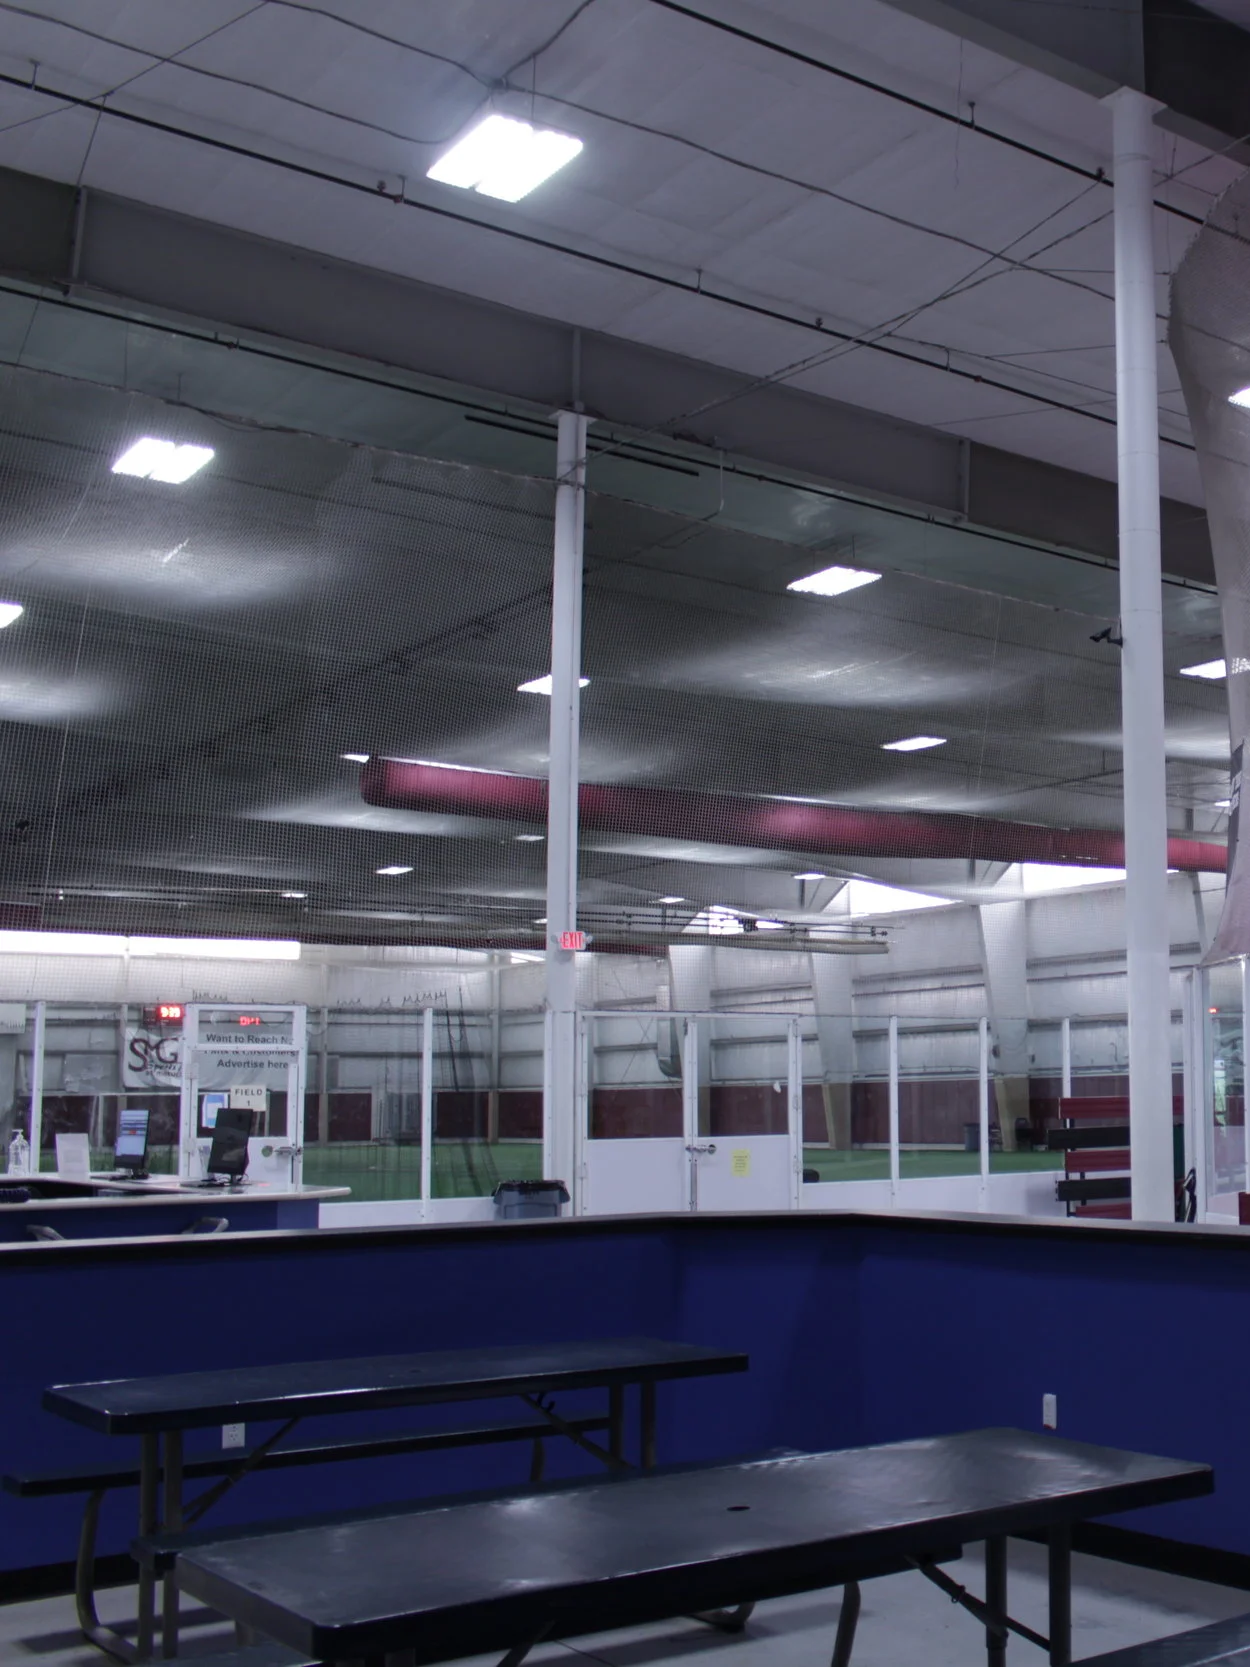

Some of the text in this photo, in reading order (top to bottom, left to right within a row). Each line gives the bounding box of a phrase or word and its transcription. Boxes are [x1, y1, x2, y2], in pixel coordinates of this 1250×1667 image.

[562, 931, 584, 949] EXIT
[206, 1033, 232, 1043] Want
[234, 1035, 245, 1043] to
[247, 1034, 278, 1044] Reach
[216, 1059, 289, 1070] Advertise here
[234, 1088, 263, 1096] FIELD
